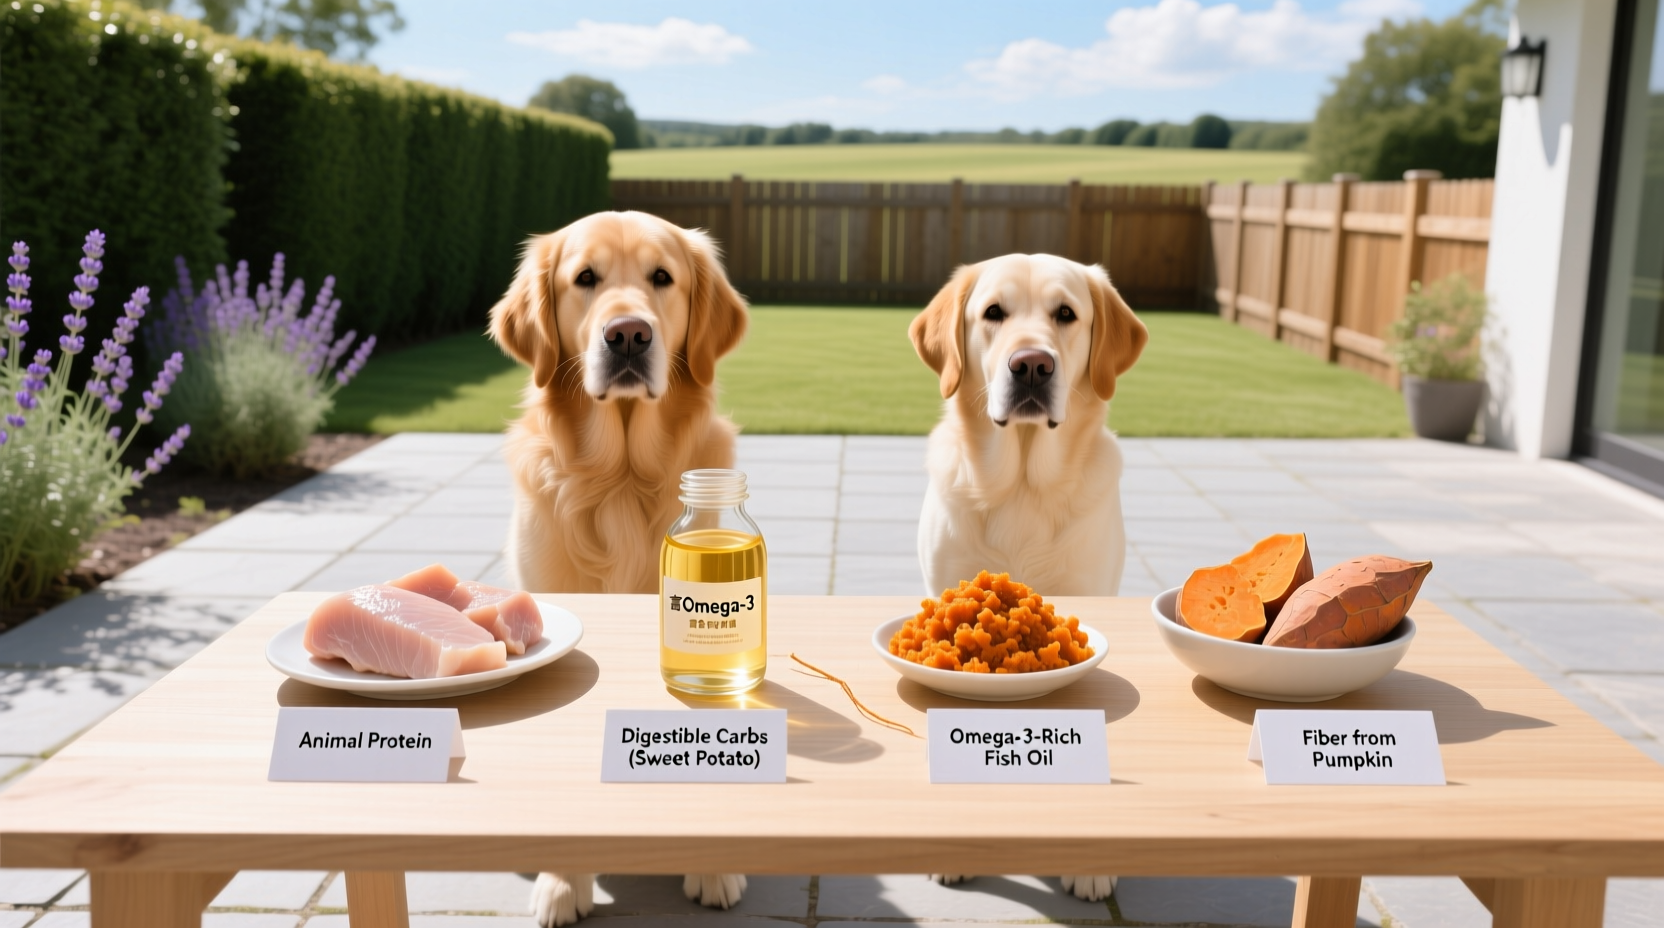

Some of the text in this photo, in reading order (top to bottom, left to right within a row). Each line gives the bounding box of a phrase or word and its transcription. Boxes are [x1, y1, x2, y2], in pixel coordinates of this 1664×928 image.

[298, 731, 432, 749] Animal Protein
[621, 727, 768, 748] Digestible Carbs
[949, 727, 1082, 749] Omega-3-Rich
[1302, 728, 1397, 746] Fiber from
[628, 749, 761, 770] (Sweet Potato)
[985, 749, 1053, 767] Fish Oil
[1312, 750, 1393, 772] Pumpkin
